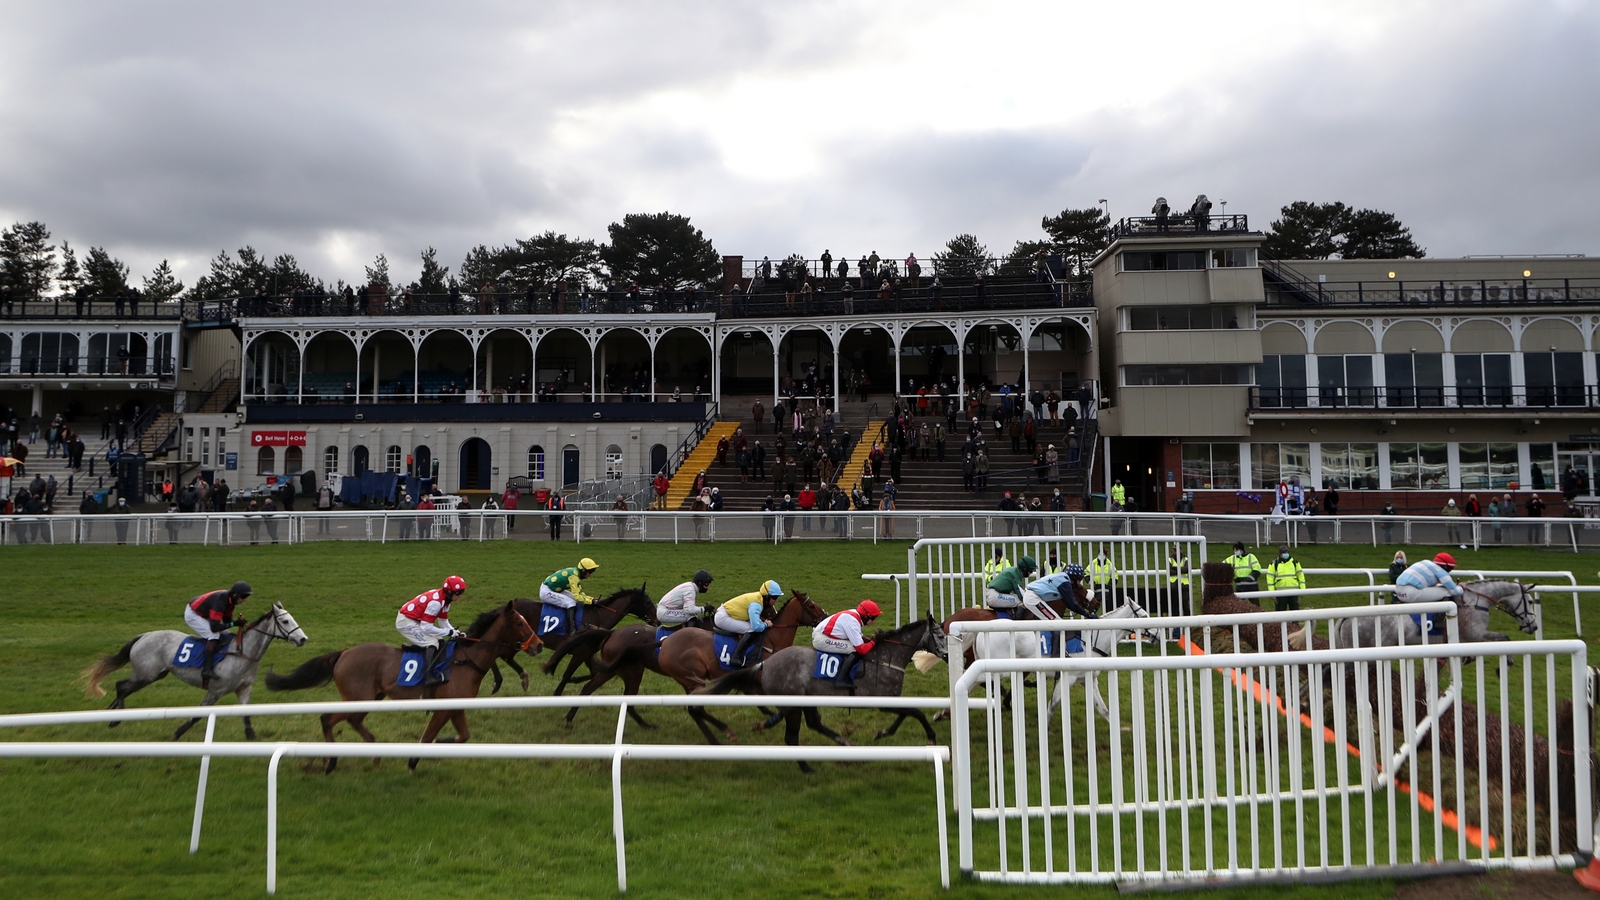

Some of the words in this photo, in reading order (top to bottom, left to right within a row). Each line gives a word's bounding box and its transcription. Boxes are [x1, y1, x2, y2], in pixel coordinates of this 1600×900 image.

[542, 615, 560, 633] 12
[178, 643, 194, 663] 5
[719, 644, 731, 665] 4
[404, 659, 418, 682] 9
[820, 653, 840, 678] 10
